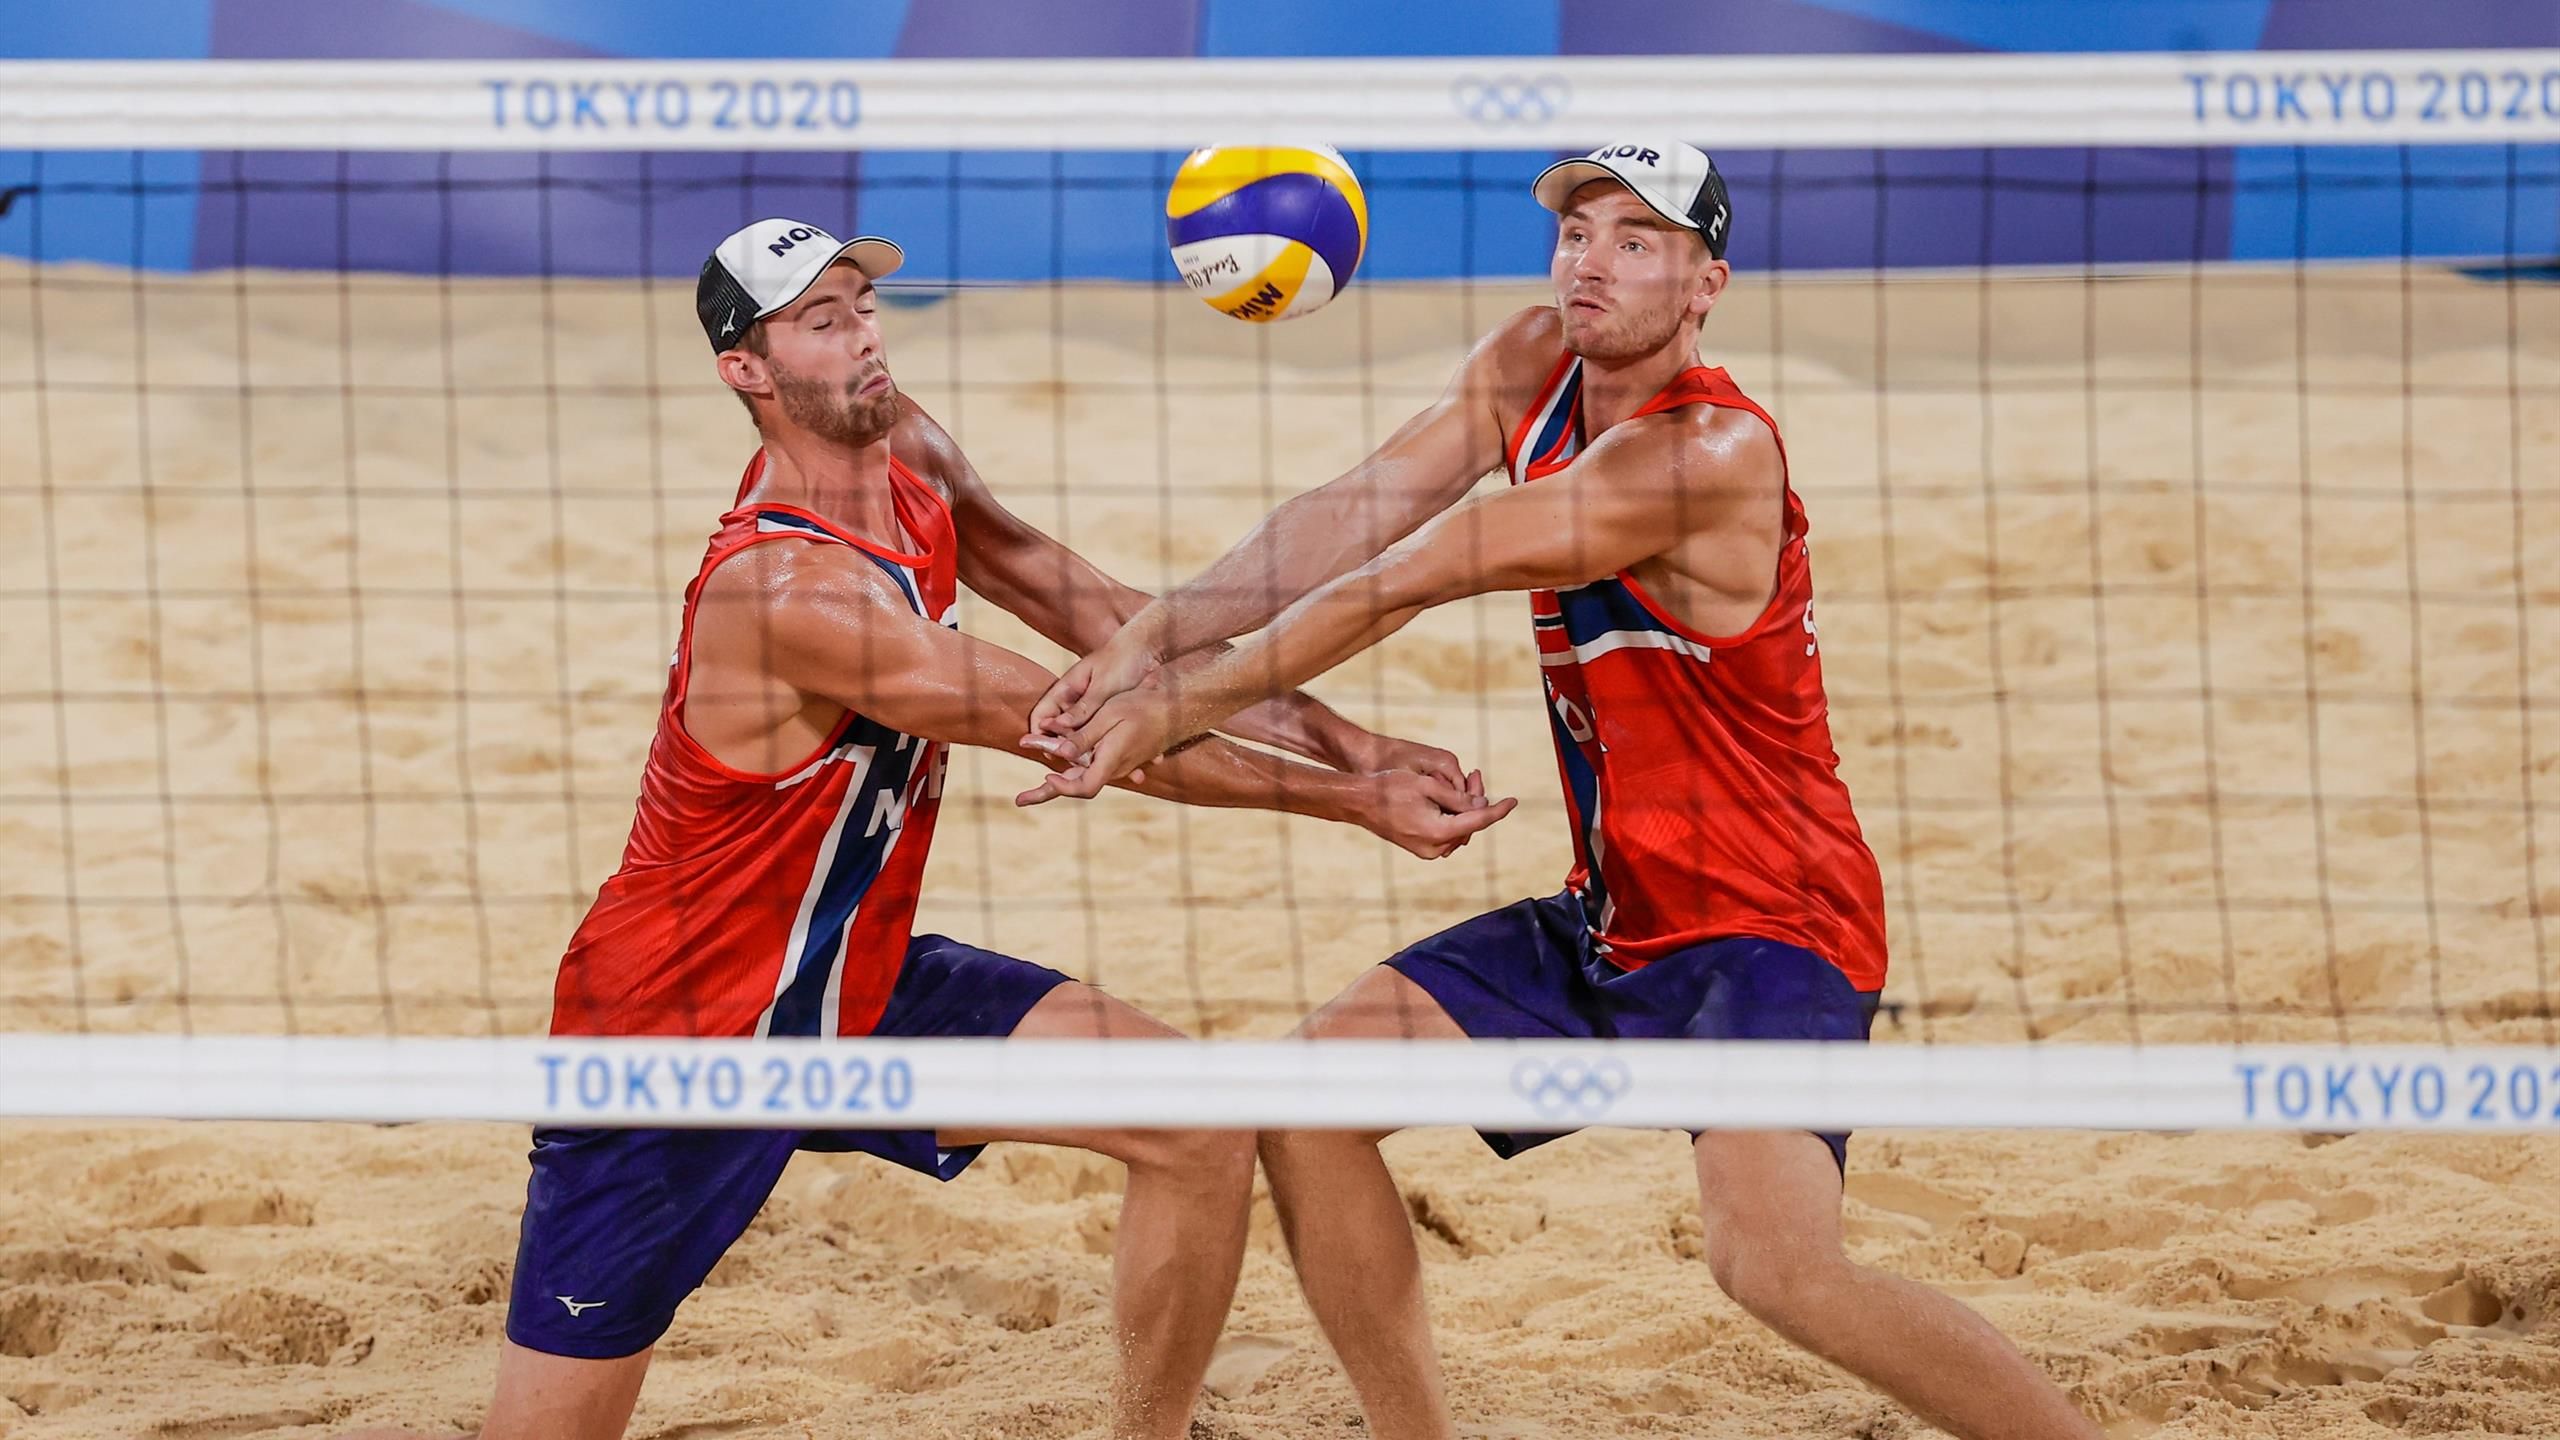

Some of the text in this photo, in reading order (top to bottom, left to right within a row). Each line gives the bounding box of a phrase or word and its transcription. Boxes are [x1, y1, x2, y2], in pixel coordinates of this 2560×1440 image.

[481, 79, 862, 130] TOKYO 2020
[2184, 73, 2396, 122] TOKYO
[1598, 144, 1661, 168] NOR
[537, 1056, 914, 1110] TOKYO 2020
[2235, 1064, 2446, 1120] TOKYO
